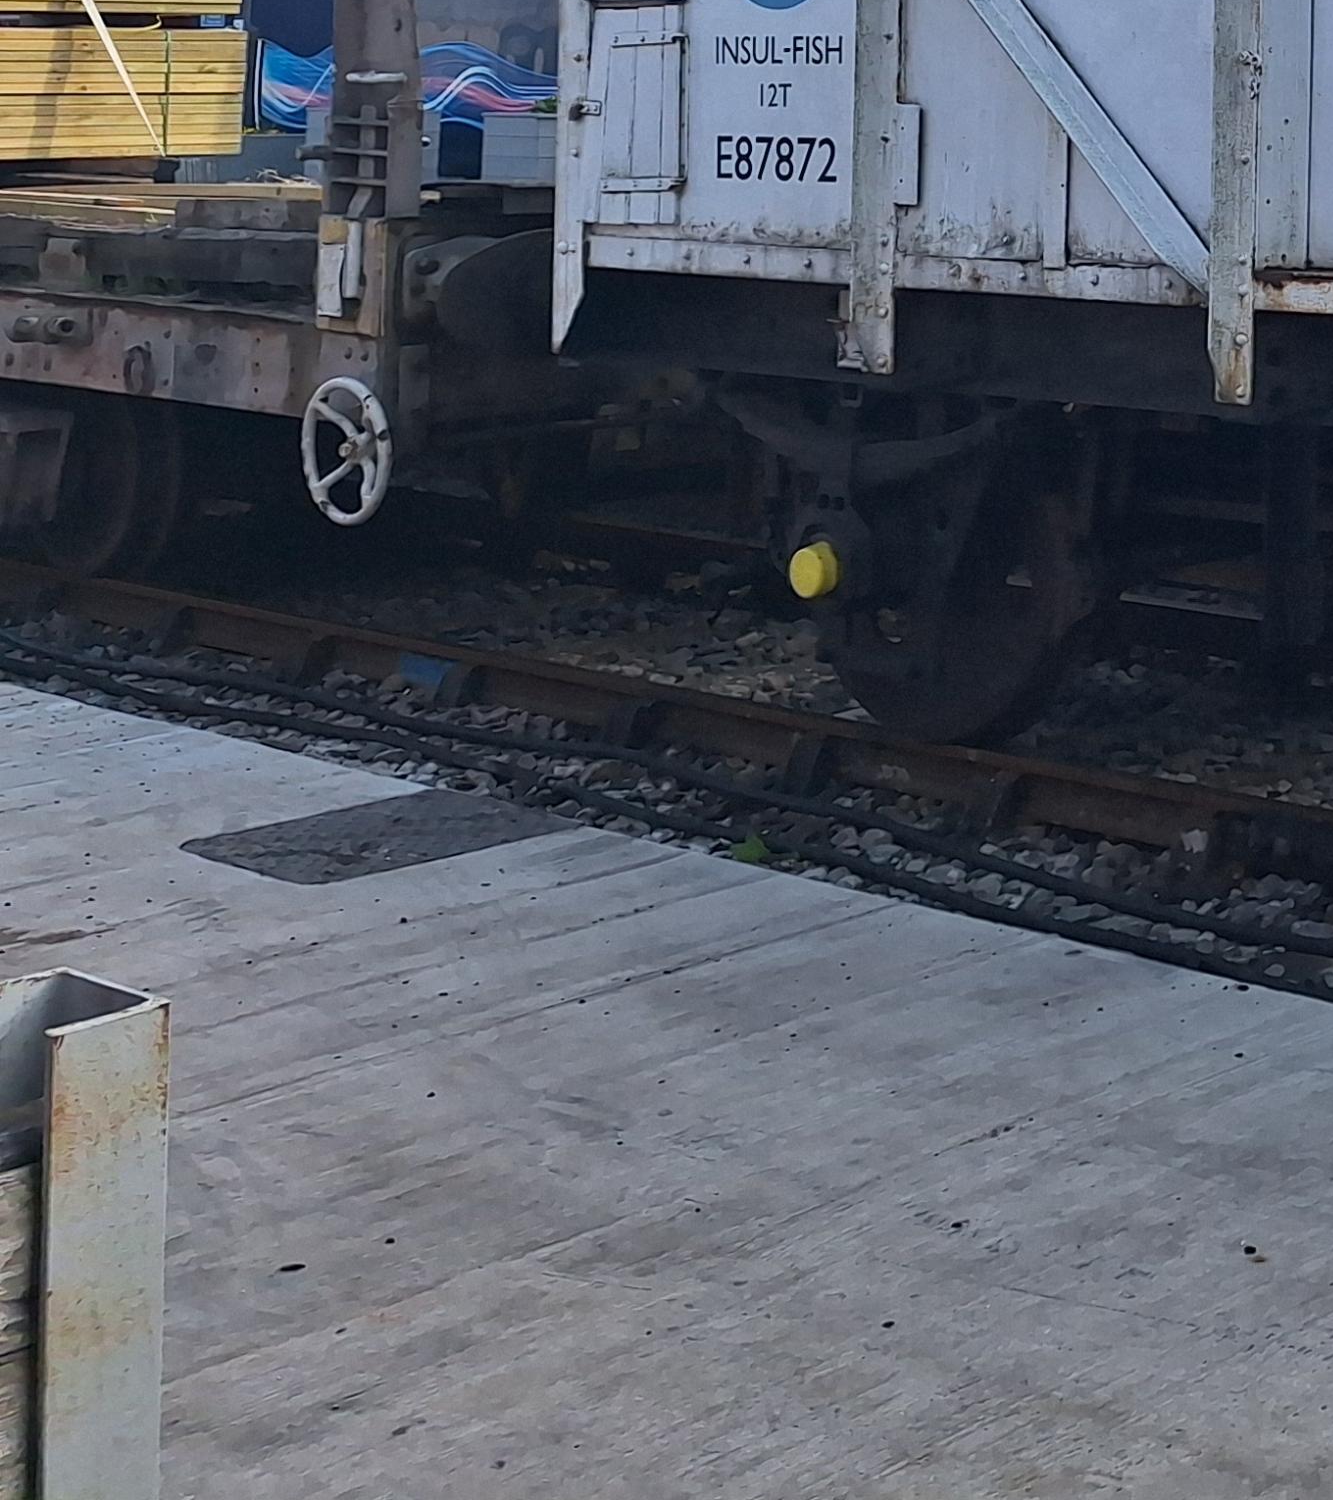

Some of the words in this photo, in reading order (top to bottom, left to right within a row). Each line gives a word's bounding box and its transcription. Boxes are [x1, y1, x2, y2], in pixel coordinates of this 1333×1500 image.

[715, 35, 843, 65] INSUL-FISH
[759, 83, 792, 108] 12T
[716, 135, 838, 183] E87872
